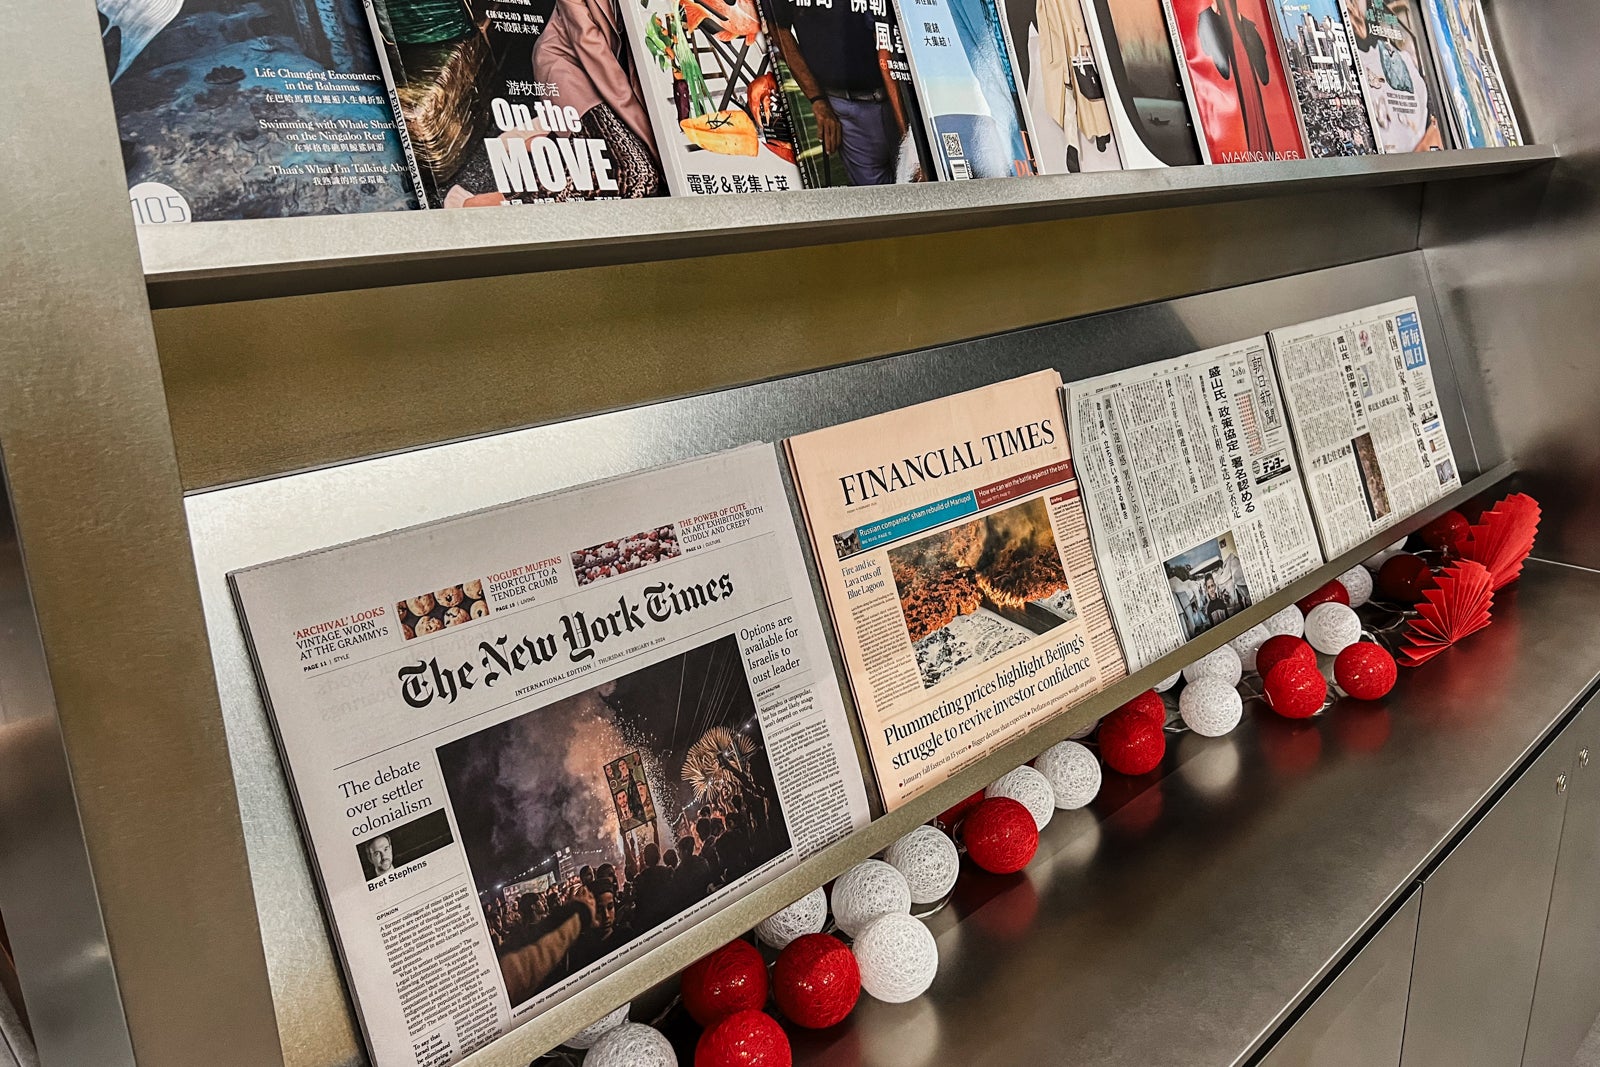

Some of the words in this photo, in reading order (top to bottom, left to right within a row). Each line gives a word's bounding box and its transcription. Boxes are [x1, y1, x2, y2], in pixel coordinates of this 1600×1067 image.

[493, 21, 540, 35] 不設限未來
[255, 68, 275, 78] Life
[278, 69, 326, 80] Changing
[329, 71, 381, 81] Encounters
[285, 81, 295, 90] in
[298, 81, 312, 90] the
[316, 82, 360, 92] Bahamas
[506, 80, 559, 96] 游牧旅活
[259, 120, 314, 130] Swimming
[316, 120, 337, 129] with
[339, 120, 368, 129] Whale
[370, 120, 399, 129] Shark
[491, 98, 534, 131] On
[534, 100, 582, 132] the
[301, 132, 316, 140] the
[319, 132, 362, 142] Ningaloo
[364, 131, 386, 140] Reef
[389, 90, 411, 150] FEBRUARY
[406, 154, 417, 178] 2024
[270, 165, 304, 175] Thaa's
[306, 164, 332, 173] What
[335, 165, 349, 173] I'm
[352, 164, 387, 175] Talking
[390, 163, 409, 173] Abo
[484, 136, 619, 193] MOVE
[1222, 151, 1262, 163] MAKING
[1265, 150, 1299, 160] WAVES
[131, 195, 186, 224] 105
[1249, 354, 1278, 426] 朝日新聞
[1207, 365, 1256, 515] 盛山氏「政策協定」署名認める
[839, 440, 982, 505] FINANCIAL
[981, 419, 1055, 461] TIMES
[978, 487, 989, 497] How
[989, 485, 996, 493] we
[995, 482, 1004, 491] can
[1004, 480, 1012, 488] win
[1018, 474, 1032, 484] battle
[1032, 468, 1049, 480] against
[1049, 465, 1057, 474] the
[1057, 462, 1068, 471] bots
[679, 517, 692, 528] THE
[693, 510, 718, 525] POWER
[719, 508, 728, 516] OF
[729, 503, 746, 515] CUTE
[681, 526, 691, 536] AN
[692, 522, 705, 533] ART
[707, 511, 745, 530] EXHIBITION
[746, 506, 764, 518] BOTH
[858, 523, 881, 537] Russian
[910, 508, 926, 519] sham
[925, 502, 944, 514] rebuild
[943, 500, 949, 508] of
[949, 493, 971, 507] Mariupol
[683, 529, 710, 543] CUDDLY
[712, 524, 725, 535] AND
[726, 517, 751, 532] CREEPY
[487, 567, 524, 583] YOGURT
[525, 556, 562, 574] MUFFINS
[489, 575, 535, 592] SHORTCUT
[535, 570, 549, 581] TO
[550, 568, 557, 576] A
[841, 564, 854, 577] Fire
[853, 559, 866, 572] and
[866, 556, 876, 568] ice
[843, 574, 859, 588] Lava
[858, 570, 872, 582] cuts
[871, 565, 882, 577] off
[492, 585, 527, 601] TENDER
[528, 576, 558, 591] CRUMB
[846, 585, 861, 599] Blue
[860, 576, 885, 596] Lagoon
[351, 607, 385, 624] LOOKS
[496, 604, 508, 612] PAGE
[296, 630, 341, 650] VINTAGE
[342, 620, 375, 637] WORN
[398, 656, 479, 708] The
[479, 633, 558, 688] New
[559, 595, 647, 662] York
[644, 571, 734, 623] Times
[740, 621, 775, 641] Options
[778, 615, 792, 626] are
[745, 632, 783, 655] available
[785, 628, 798, 639] for
[299, 646, 315, 660] AT
[316, 641, 336, 656] THE
[337, 626, 389, 652] GRAMMYS
[303, 662, 319, 672] PAGE
[515, 672, 564, 697] INTERNATIONAL
[566, 662, 591, 677] EDITION
[625, 640, 649, 655] FEBRUARY
[748, 649, 779, 670] Israelis
[781, 647, 791, 656] to
[752, 669, 771, 685] oust
[772, 658, 800, 676] leader
[884, 695, 964, 746] Plummeting
[963, 681, 996, 708] prices
[996, 655, 1046, 689] highlight
[1044, 634, 1085, 665] Beijing's
[892, 728, 944, 770] struggle
[944, 725, 958, 742] to
[959, 707, 993, 735] revive
[993, 684, 1036, 716] investor
[1037, 656, 1090, 694] confidence
[901, 768, 921, 786] January
[929, 755, 946, 771] fastest
[954, 744, 968, 757] years
[971, 734, 986, 748] Bigger
[984, 726, 1000, 741] decline
[999, 721, 1010, 733] than
[1008, 712, 1028, 728] expected
[1030, 699, 1051, 716] Deflation
[1049, 690, 1068, 705] pressures
[1083, 675, 1097, 687] profits
[338, 778, 371, 799] The
[374, 760, 421, 786] debate
[346, 797, 378, 818] over
[382, 778, 424, 804] settler
[352, 796, 432, 836] colonialism
[367, 878, 387, 892] Bret
[388, 860, 428, 882] Stephens
[377, 907, 399, 920] OPINION
[413, 1042, 420, 1050] To
[420, 1039, 429, 1047] say
[429, 1031, 440, 1041] that
[417, 1056, 423, 1064] be
[423, 1041, 450, 1060] eliminated
